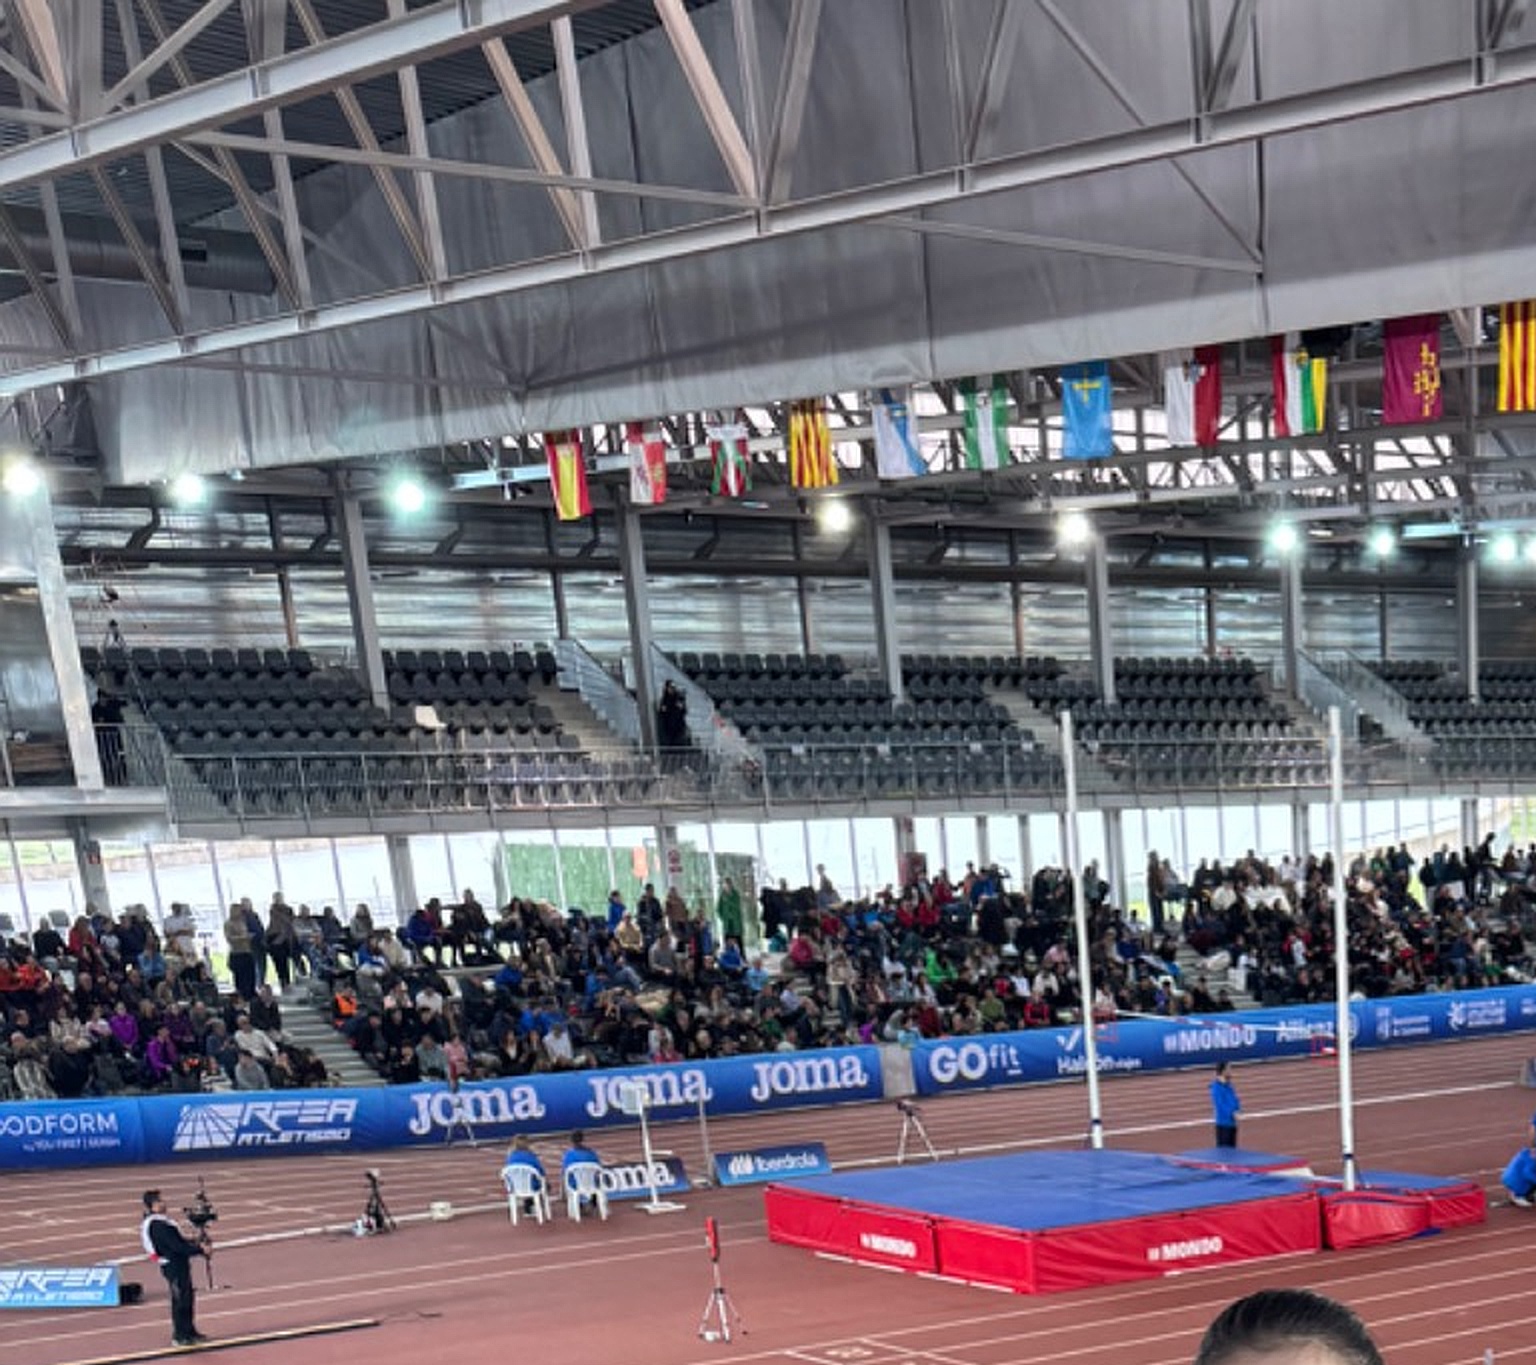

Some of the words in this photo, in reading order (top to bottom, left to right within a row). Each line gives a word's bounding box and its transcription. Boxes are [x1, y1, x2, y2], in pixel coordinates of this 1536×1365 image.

[1180, 1024, 1257, 1053] MONDO
[752, 1054, 868, 1101] Joma
[243, 1098, 358, 1132] RFEA
[409, 1084, 546, 1135] Joma
[599, 1161, 675, 1192] oma
[871, 1233, 917, 1258] MONDO
[1162, 1235, 1223, 1261] MONDO
[17, 1267, 113, 1293] RFEA
